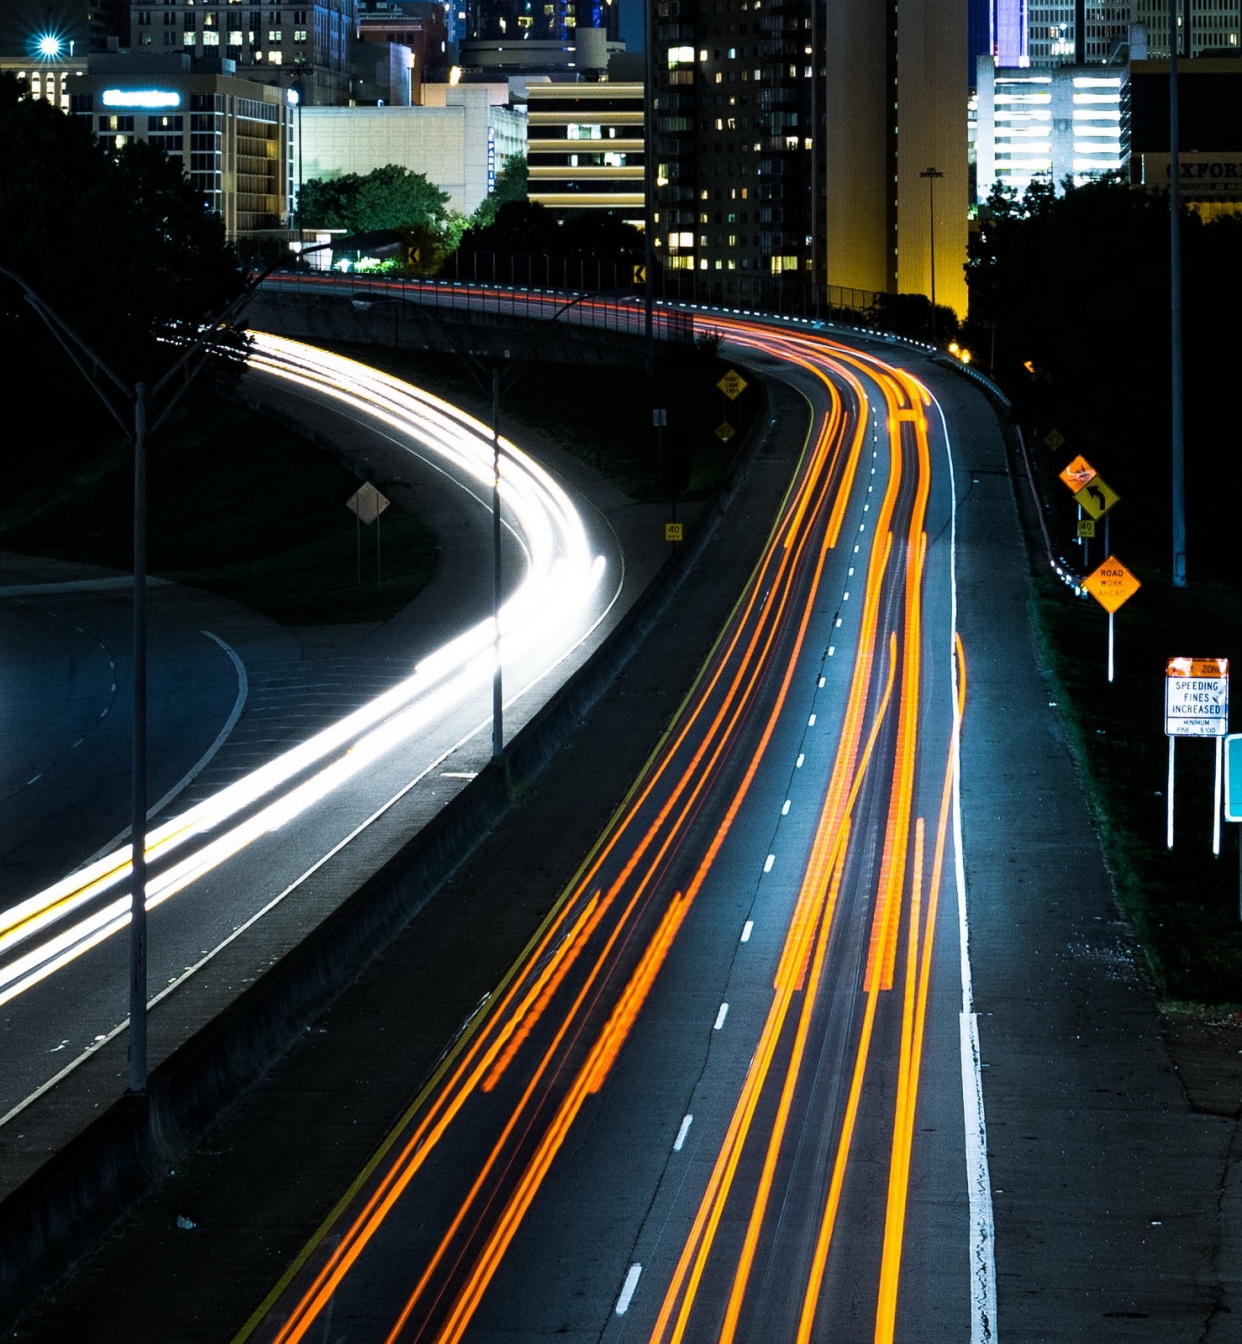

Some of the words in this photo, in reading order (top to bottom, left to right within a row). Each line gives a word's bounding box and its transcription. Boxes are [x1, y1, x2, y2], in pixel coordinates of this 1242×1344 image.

[487, 143, 495, 193] PARKING
[1167, 163, 1242, 177] XFOR
[668, 526, 680, 534] 40
[1081, 522, 1092, 531] 40
[1100, 569, 1124, 577] ROAD
[1175, 681, 1219, 691] SPEEDING
[1184, 693, 1210, 702] FINES
[1172, 704, 1221, 714] INCREASED
